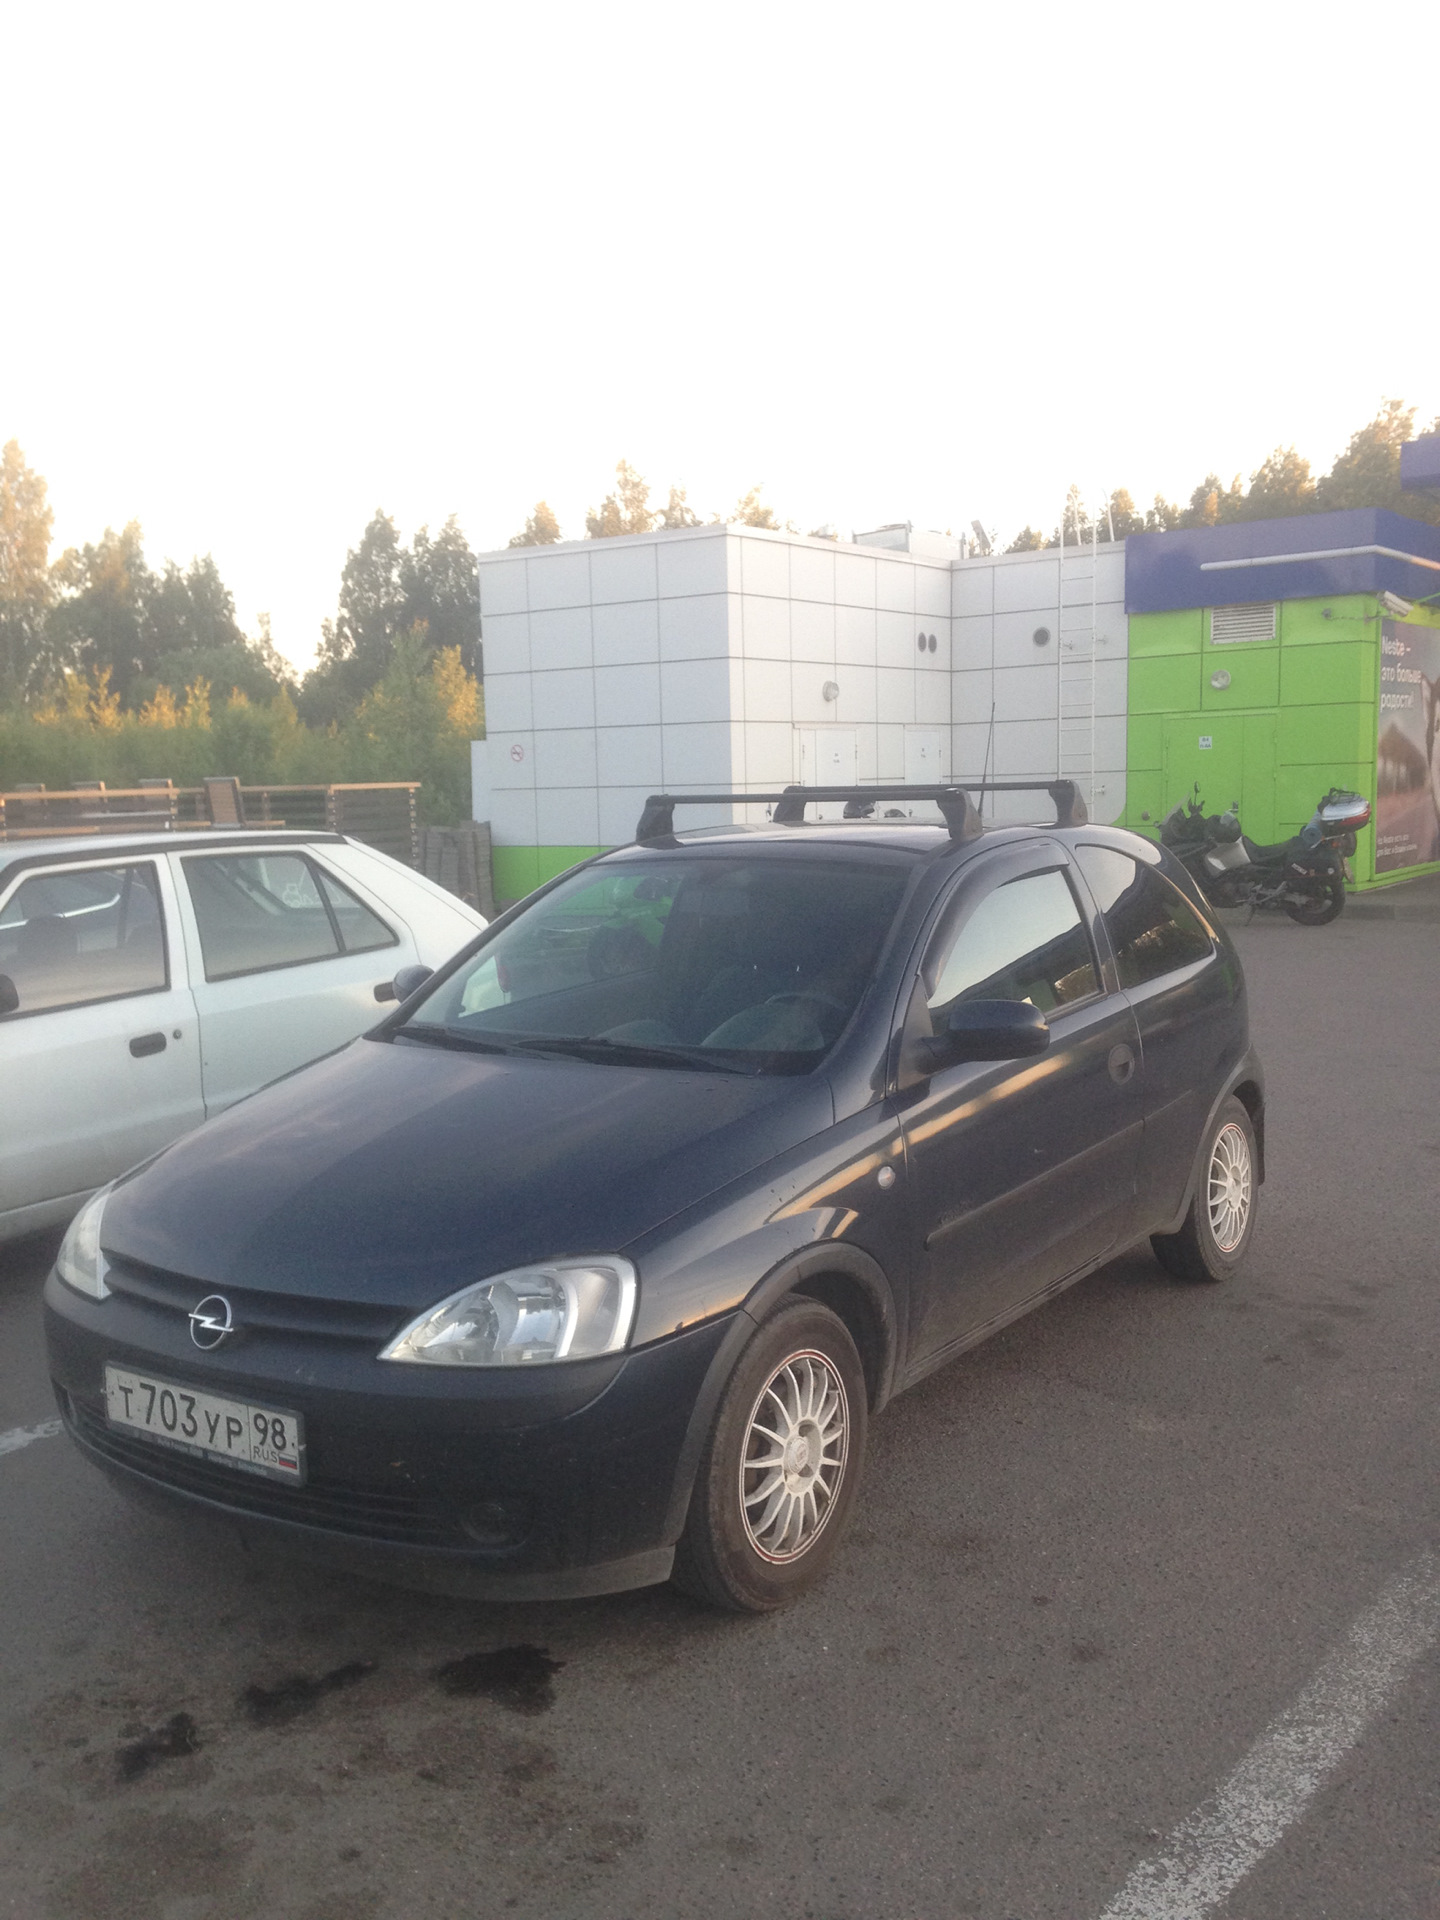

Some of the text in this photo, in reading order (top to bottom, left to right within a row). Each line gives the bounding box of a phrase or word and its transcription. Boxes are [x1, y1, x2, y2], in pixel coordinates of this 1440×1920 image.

[1381, 635, 1405, 657] Neste
[1381, 662, 1422, 684] это больше
[253, 1412, 287, 1451] 98
[253, 1445, 278, 1464] RUS
